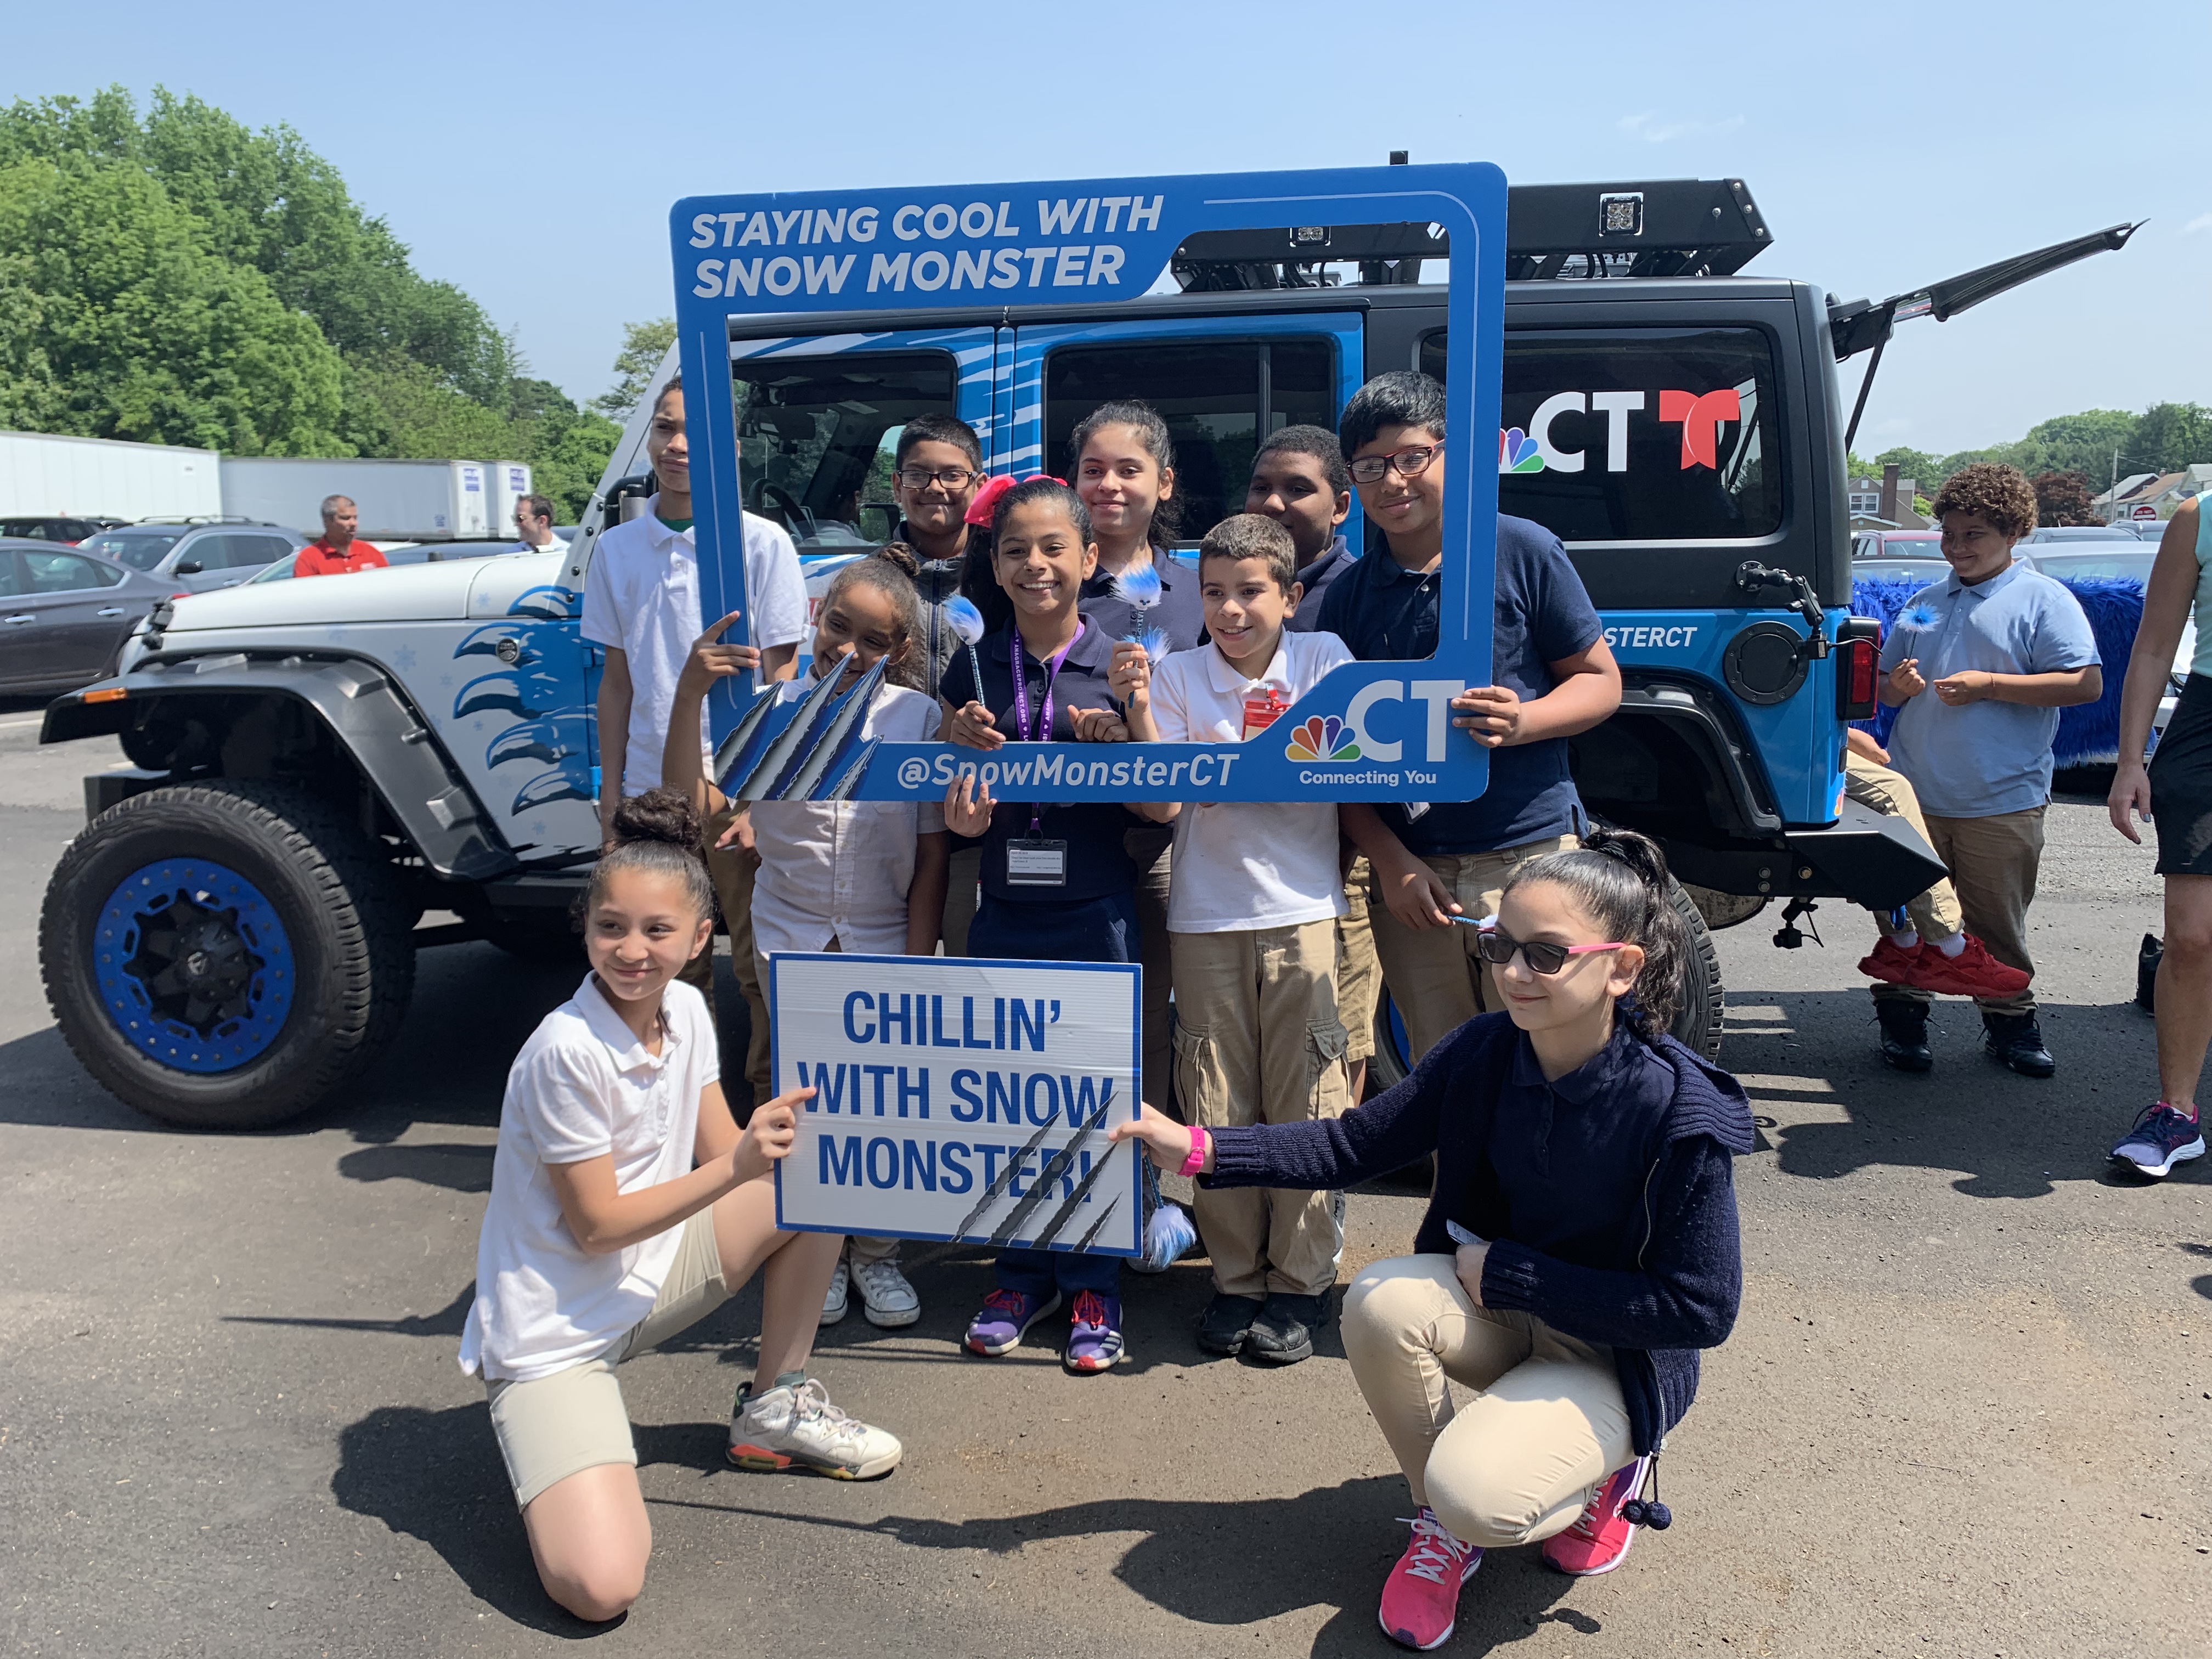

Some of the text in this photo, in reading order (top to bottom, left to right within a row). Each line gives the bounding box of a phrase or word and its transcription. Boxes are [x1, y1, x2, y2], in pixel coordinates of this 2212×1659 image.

[689, 195, 1164, 249] STAYING COOL WITH
[692, 244, 1126, 298] SNOW MONSTER
[1528, 391, 1644, 473] CT
[1014, 644, 1026, 723] ANAGRACEPROJECT.ORG
[1345, 679, 1465, 762] CT
[897, 753, 1240, 789] @SnowMonsterCT
[1299, 770, 1436, 787] Connecting You
[797, 1061, 1113, 1130] WITH SNOW
[818, 1134, 1091, 1203] MONSTER!
